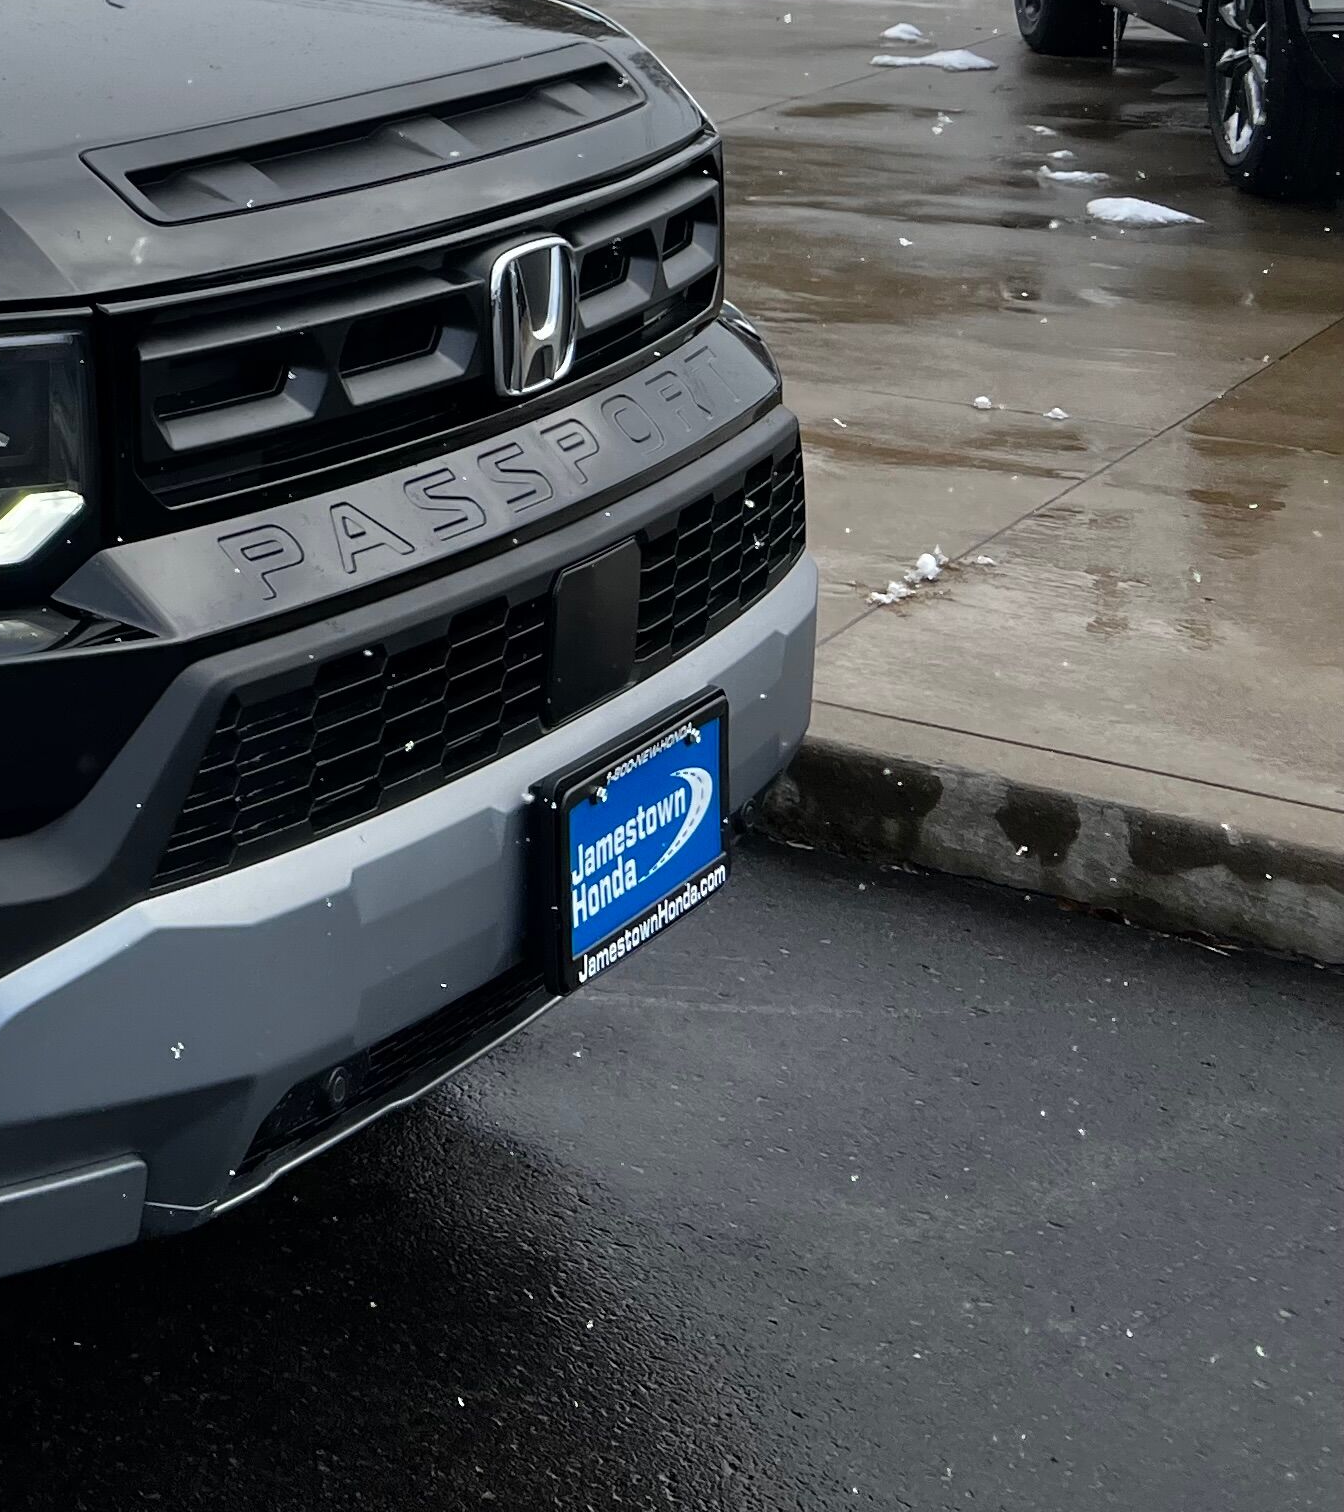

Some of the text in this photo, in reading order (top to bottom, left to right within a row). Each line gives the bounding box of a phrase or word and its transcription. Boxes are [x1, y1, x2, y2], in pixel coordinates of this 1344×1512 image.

[217, 345, 744, 601] PASSPORT
[571, 785, 687, 884] Jamestown
[573, 856, 638, 929] Honda
[578, 862, 726, 984] JamestownHonda.com
